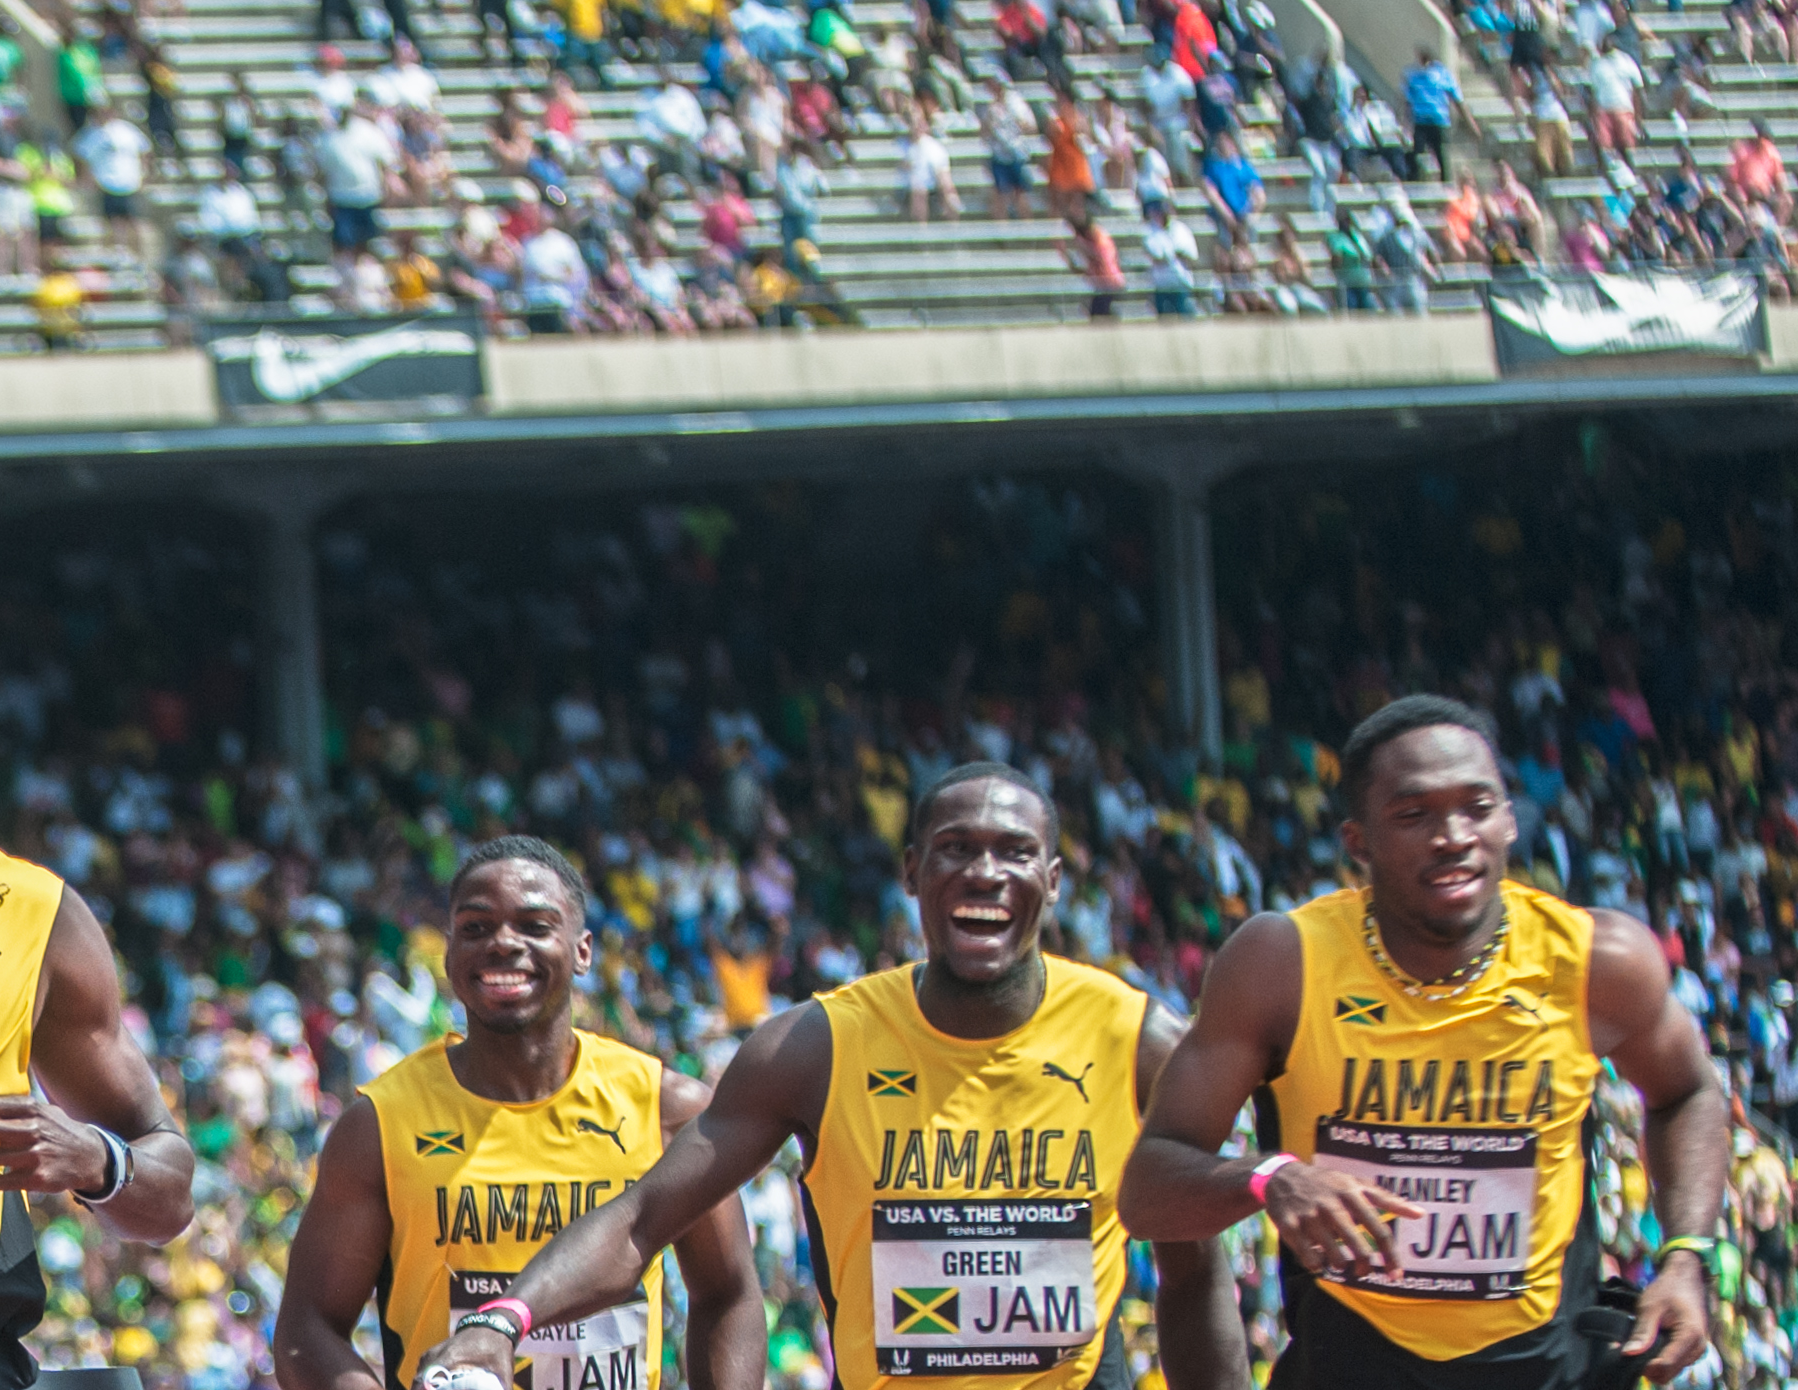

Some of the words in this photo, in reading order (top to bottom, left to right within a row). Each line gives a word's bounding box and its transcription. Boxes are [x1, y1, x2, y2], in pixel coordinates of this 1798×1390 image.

[1333, 1057, 1555, 1123] JAMAICA
[1330, 1126, 1371, 1146] USA
[1373, 1132, 1406, 1150] VS.
[1407, 1133, 1450, 1151] THE
[1451, 1135, 1527, 1152] WORLD
[874, 1129, 1097, 1190] JAMAICA
[435, 1179, 637, 1247] JAMAIC
[886, 1207, 925, 1224] USA
[929, 1207, 960, 1223] VS.
[963, 1206, 1003, 1222] THE
[1005, 1205, 1077, 1223] WORLD
[947, 1226, 976, 1236] PENN
[977, 1226, 1017, 1236] RELAYS
[1409, 1212, 1521, 1260] JAM
[942, 1251, 1022, 1276] GREEN
[464, 1278, 503, 1295] USA
[974, 1286, 1082, 1334] JAM
[927, 1353, 1040, 1367] PHILADELPHIA
